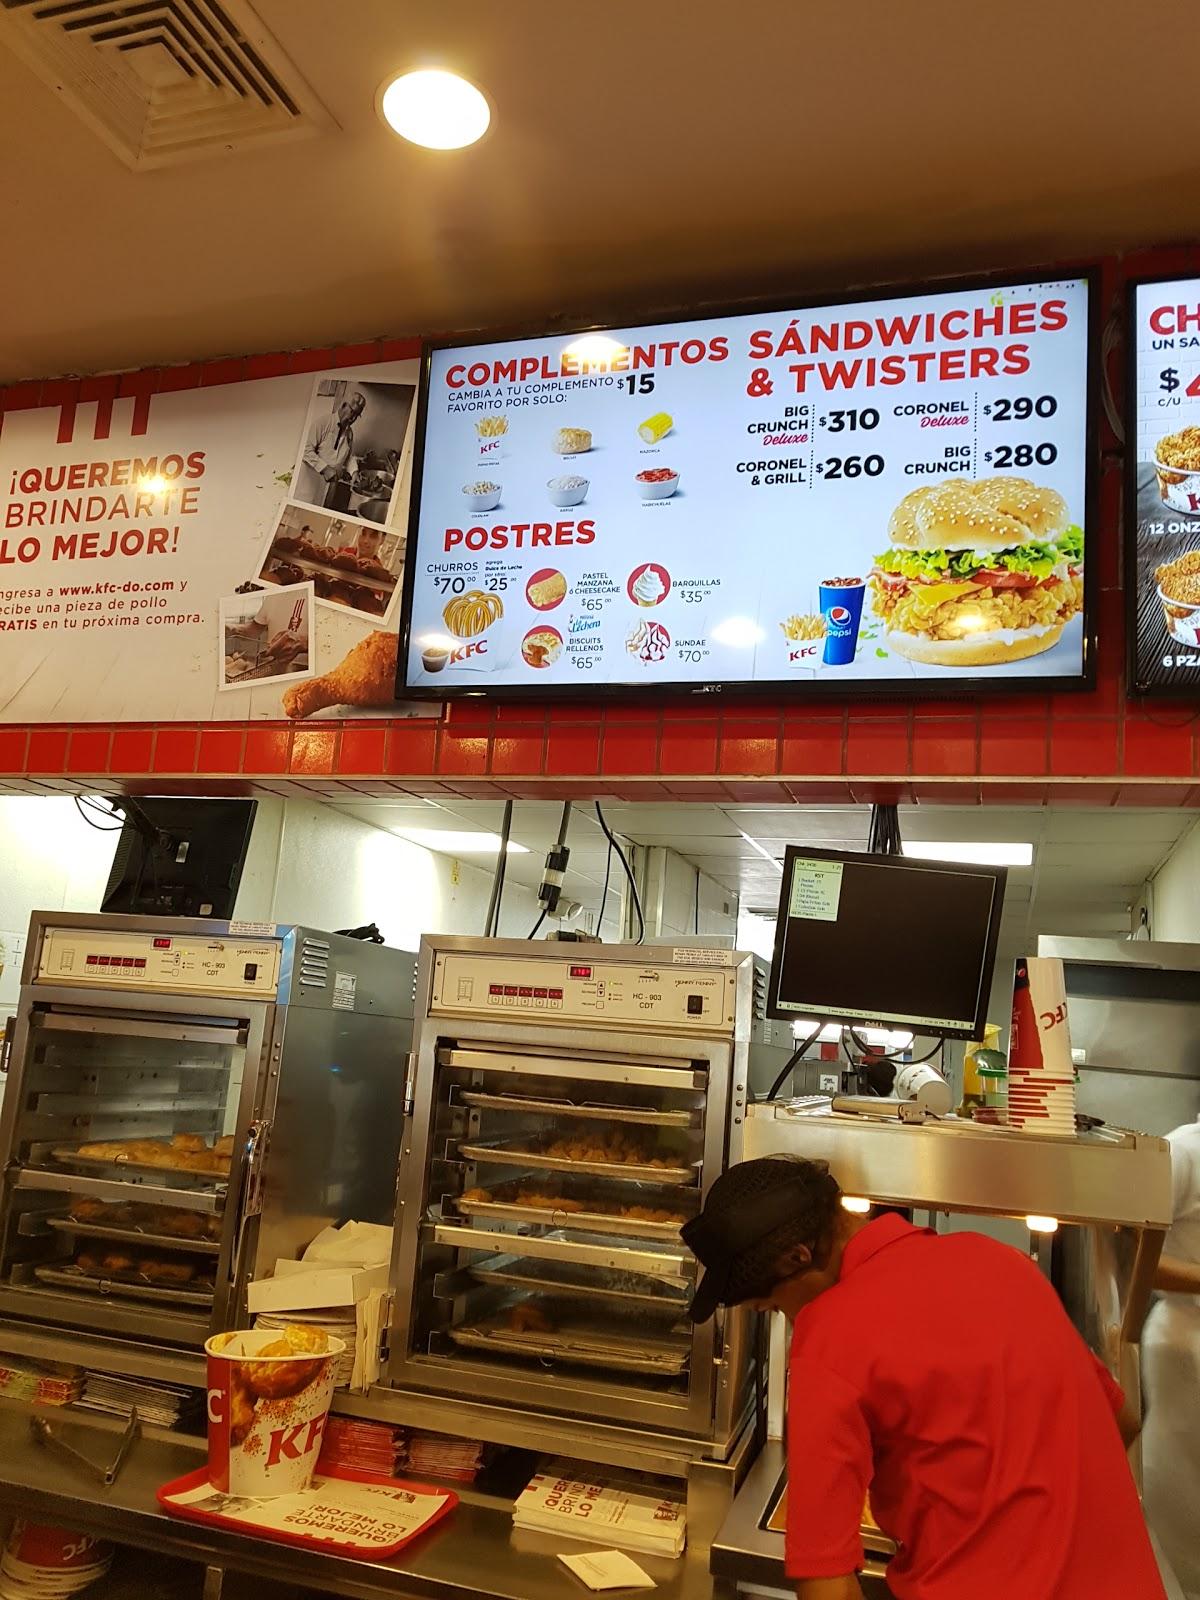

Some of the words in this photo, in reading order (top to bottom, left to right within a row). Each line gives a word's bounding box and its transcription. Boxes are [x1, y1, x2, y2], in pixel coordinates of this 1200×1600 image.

[748, 300, 1069, 359] SÁNDWICHES
[1152, 339, 1174, 350] UN
[746, 367, 774, 398] &
[788, 344, 1031, 394] TWISTERS
[448, 389, 491, 401] CAMBIA
[495, 388, 503, 398] A
[507, 386, 522, 396] TU
[525, 377, 614, 394] COMPLEMENTO
[617, 373, 655, 395] $15
[447, 400, 502, 413] FAVORITO
[505, 397, 530, 408] POR
[533, 394, 567, 405] SOLO:
[893, 401, 969, 416] CORONEL
[983, 395, 1058, 422] $290
[1158, 397, 1181, 407] C/U
[784, 405, 809, 417] BIG
[747, 420, 808, 434] CRUNCH
[819, 408, 880, 432] $310
[920, 415, 970, 428] Deluxe
[763, 433, 808, 446] Deluxe
[480, 441, 500, 454] KFC
[944, 446, 971, 458] BIG
[984, 442, 1058, 469] $280
[9, 451, 206, 495] ¡QUEREMOS
[736, 458, 807, 473] CORONEL
[815, 454, 885, 480] $260
[904, 460, 971, 475] CRUNCH
[751, 475, 761, 486] &
[764, 472, 806, 485] GRILL
[5, 487, 200, 528] BRINDARTE
[444, 520, 596, 552] POSTRES
[1150, 523, 1164, 535] 12
[0, 537, 41, 564] LO
[52, 526, 180, 561] MEJOR!
[427, 562, 478, 573] CHURROS
[46, 588, 54, 597] a
[59, 580, 174, 596] www.kfc-do.com
[179, 579, 188, 592] y
[574, 586, 621, 594] CHEESECAKE
[577, 579, 613, 587] MANZANA
[672, 579, 721, 588] BARQUILLAS
[37, 604, 60, 613] una
[65, 600, 102, 614] pieza
[108, 599, 125, 610] de
[130, 597, 167, 609] pollo
[42, 620, 58, 629] en
[64, 618, 77, 629] tu
[83, 614, 140, 629] próxima
[145, 612, 205, 628] compra.
[569, 637, 601, 645] BISCUITS
[450, 639, 488, 665] KFC
[789, 646, 817, 662] KFC
[1163, 655, 1173, 667] 6
[309, 1504, 378, 1524] MEJOR!
[295, 1508, 400, 1539] BRINDARTE
[382, 1522, 407, 1533] LO
